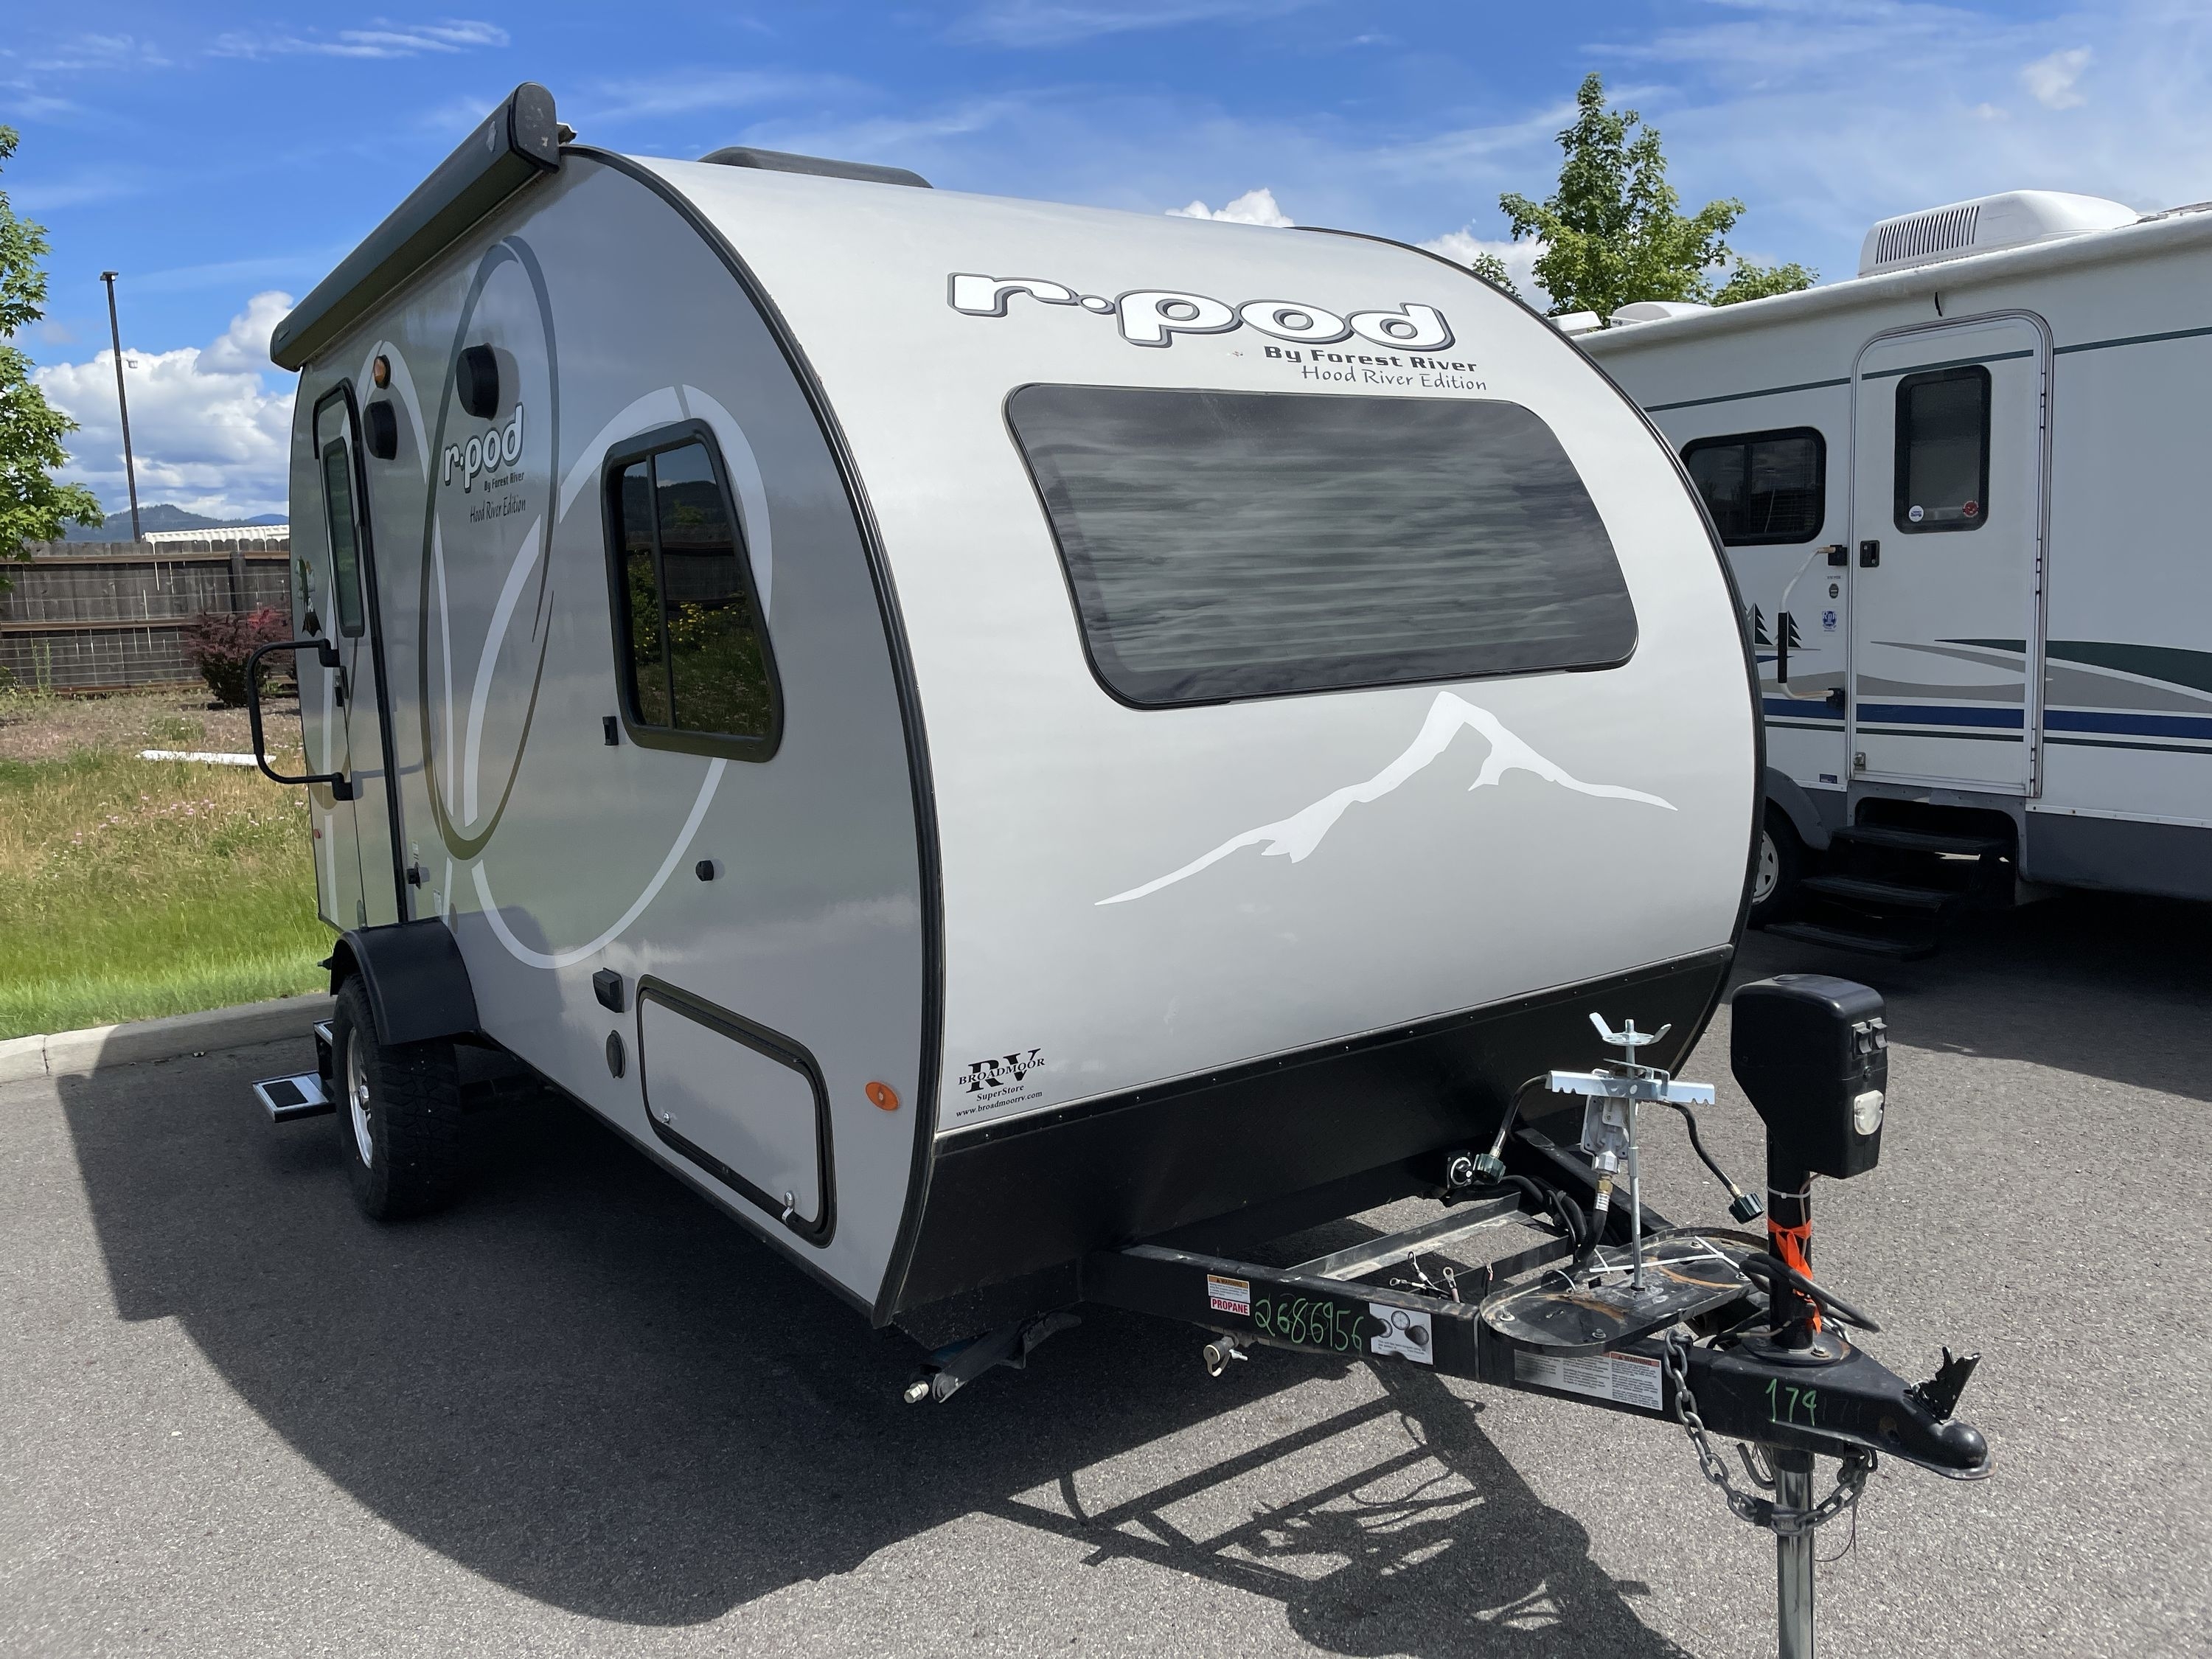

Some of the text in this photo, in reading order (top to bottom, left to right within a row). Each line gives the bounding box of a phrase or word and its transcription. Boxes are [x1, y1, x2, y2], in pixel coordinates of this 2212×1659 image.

[1264, 345, 1478, 372] By Forest River
[1301, 366, 1486, 390] Hood River Edition
[484, 471, 524, 493] By Forest River
[470, 493, 526, 523] Hood River Edition
[959, 1058, 1046, 1085] BROADMOOR
[966, 1048, 1041, 1093] RV
[956, 1091, 1043, 1117] www.broadmoorrv.com
[976, 1085, 1024, 1102] SuperStore
[1212, 1298, 1248, 1314] PROPANE
[1255, 1298, 1364, 1352] 2686956
